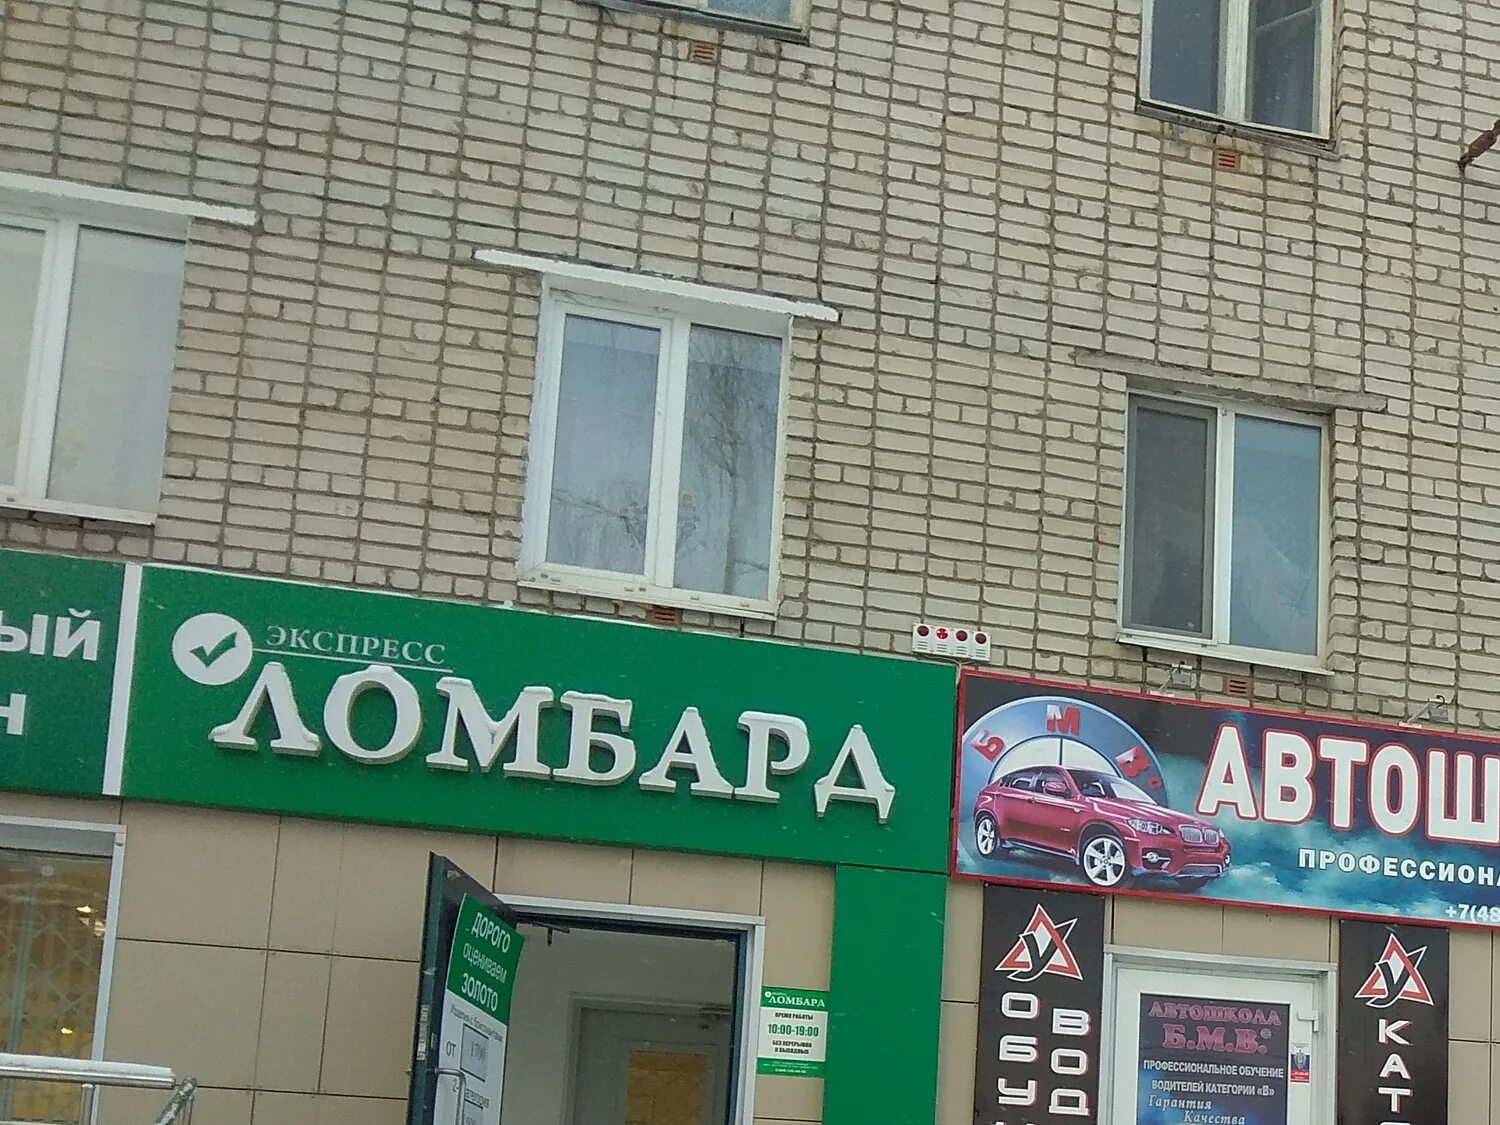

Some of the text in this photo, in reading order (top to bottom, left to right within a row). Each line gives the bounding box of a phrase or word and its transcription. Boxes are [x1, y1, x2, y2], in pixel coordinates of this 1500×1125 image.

[266, 625, 446, 665] ЭКСПРЕСС
[206, 661, 898, 825] ЛОМБАРД
[471, 912, 510, 953] ДОРОГО
[463, 942, 507, 984] оцениваем
[462, 973, 498, 1012] ЗОЛОТО
[768, 995, 826, 1007] ЛОМБАРД
[1148, 1001, 1282, 1026] АВТОШКОЛА
[768, 1024, 819, 1037] 10:00-19:00
[1143, 1059, 1238, 1075] ПРОФЕССИОНАЛЬНОЕ
[1239, 1067, 1284, 1078] ОБУЧЕНИЕ
[1151, 1079, 1204, 1094] ВОДИТЕЛЕЙ
[1205, 1083, 1256, 1096] КАТЕГОРИИ
[1149, 1094, 1212, 1111] Гарантия
[1183, 1110, 1246, 1125] Качества
